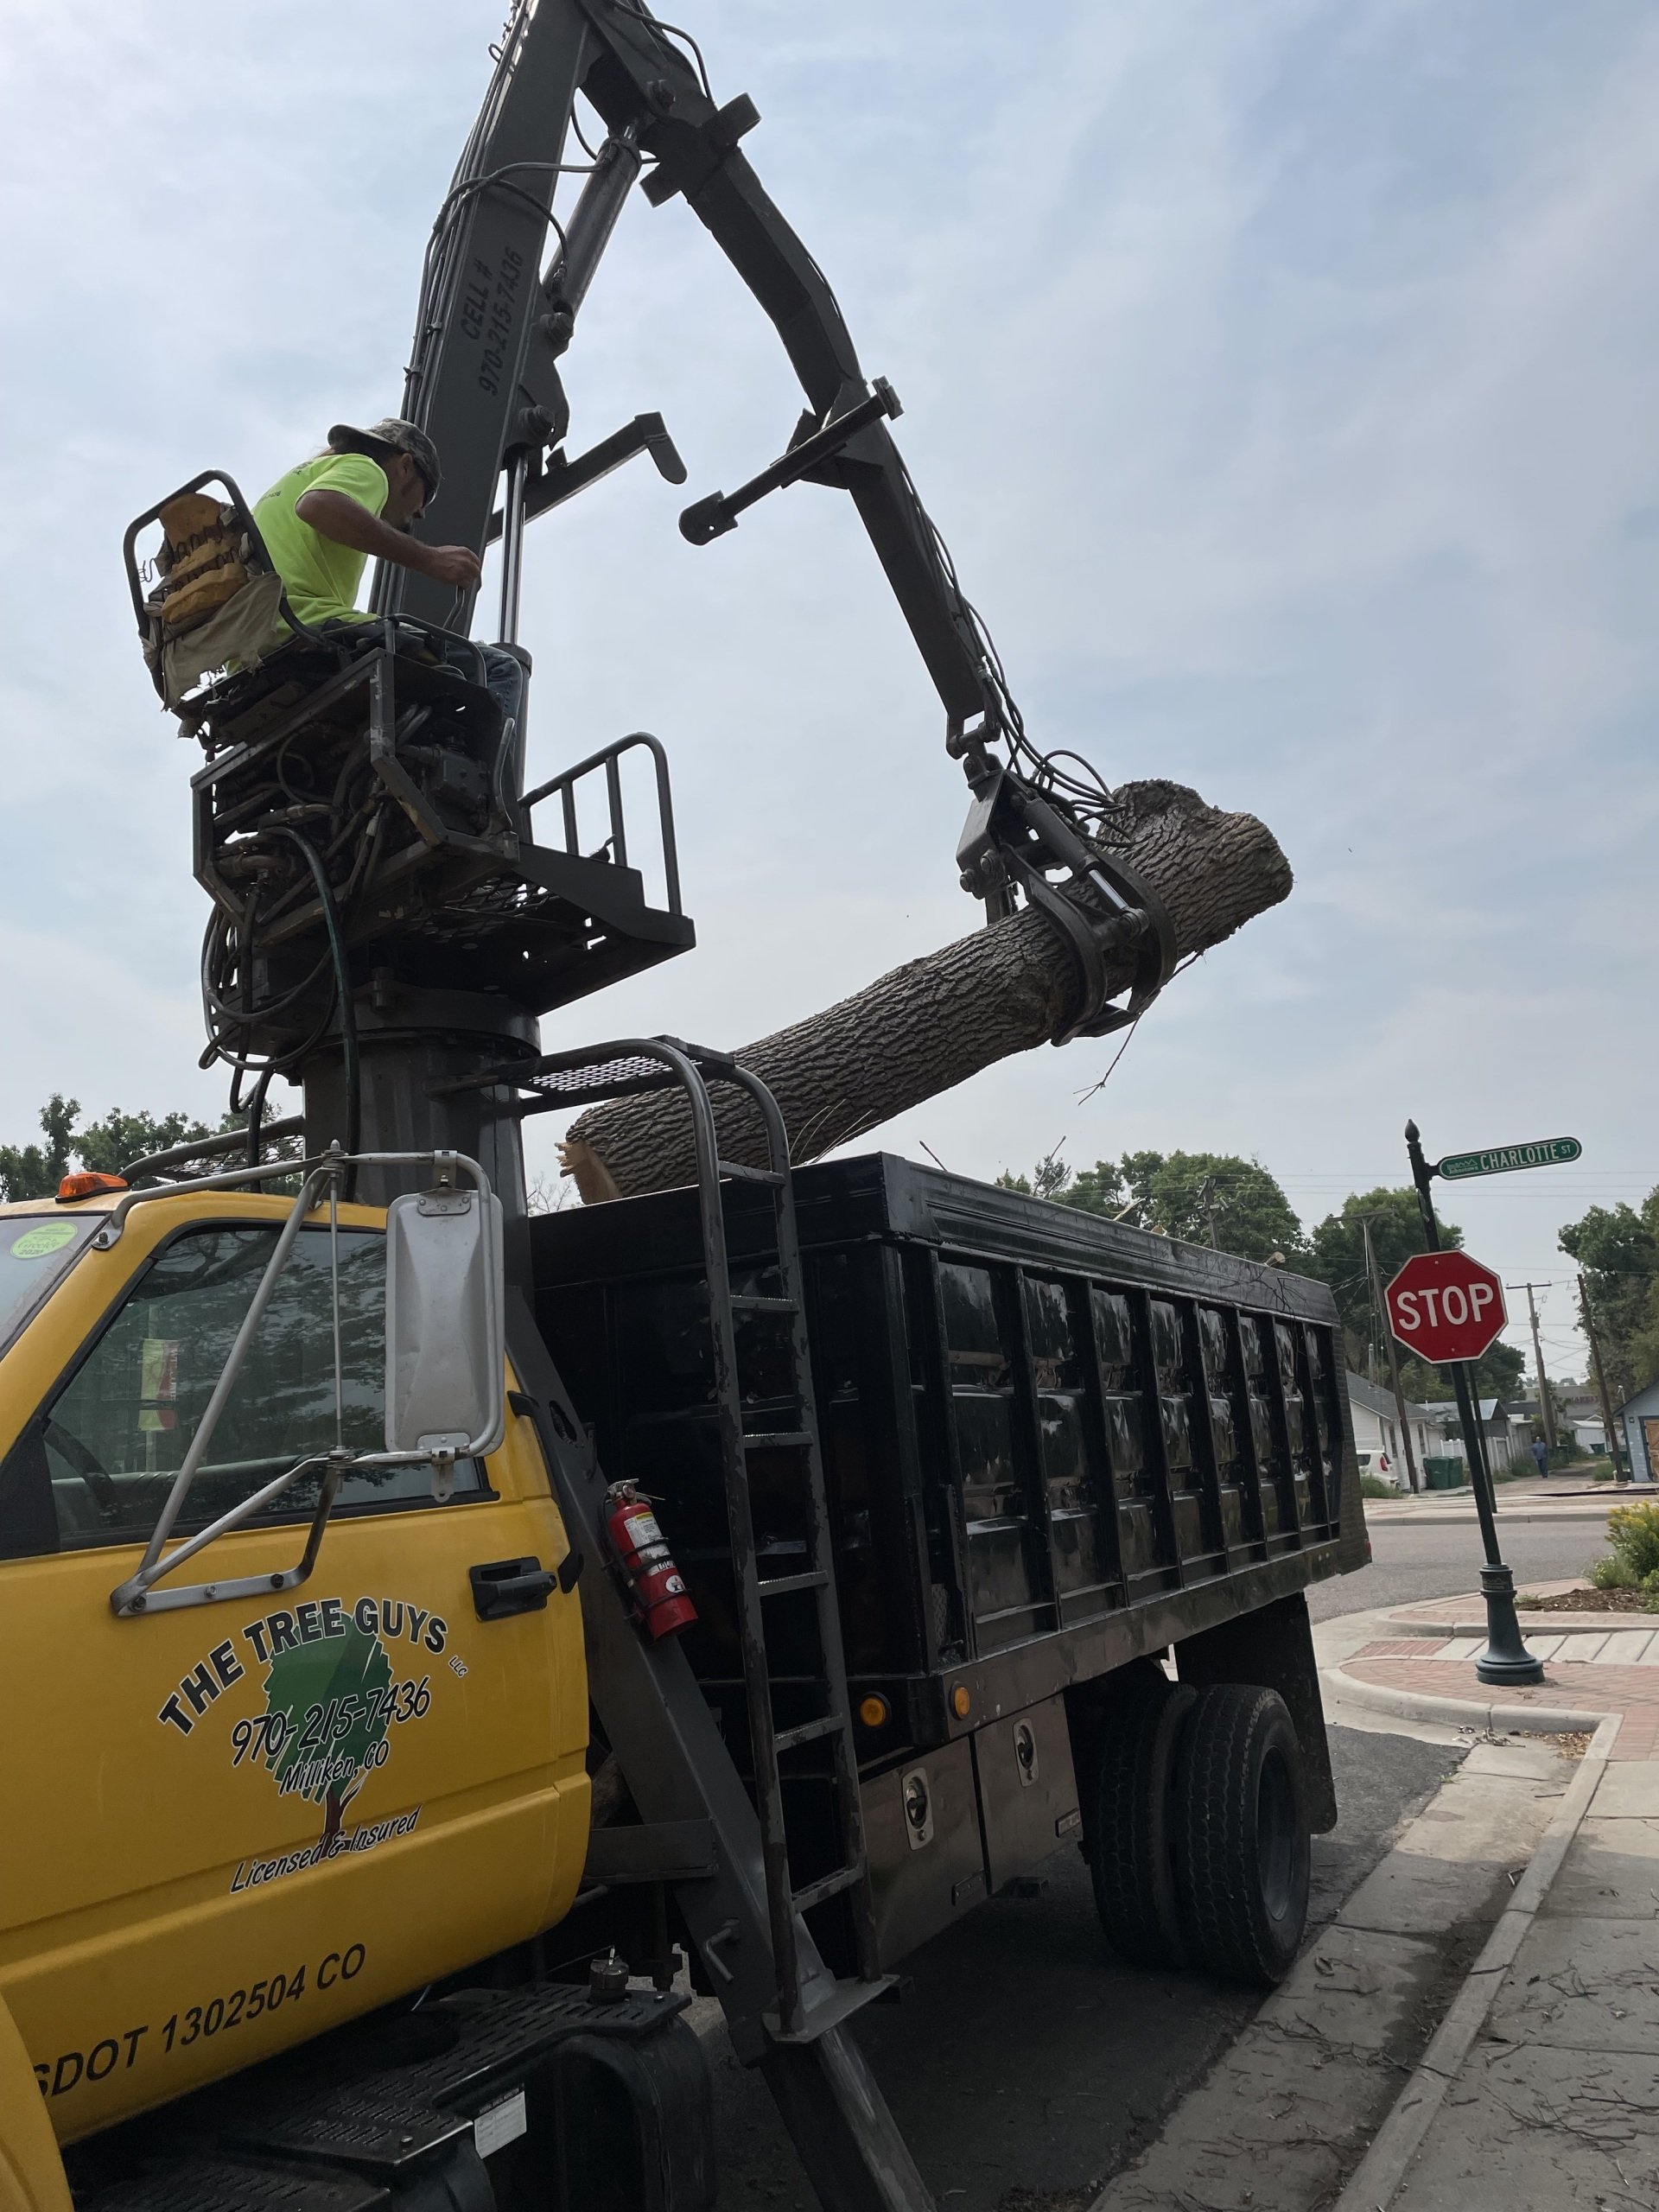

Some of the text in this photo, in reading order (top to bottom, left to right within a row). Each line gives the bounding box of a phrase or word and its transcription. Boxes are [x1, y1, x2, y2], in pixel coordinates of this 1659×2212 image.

[460, 283, 490, 340] CELL
[479, 246, 523, 397] 970-215-7436
[1480, 1143, 1572, 1170] CHARLOTTE ST
[1396, 1282, 1494, 1331] STOP
[157, 1596, 468, 1737] THE TREE GUYS LLC
[277, 1738, 391, 1797] Milliken, CO
[229, 1803, 423, 1894] Licensed & Insured
[162, 1964, 308, 2054] 1302504
[316, 1942, 366, 1990] CO
